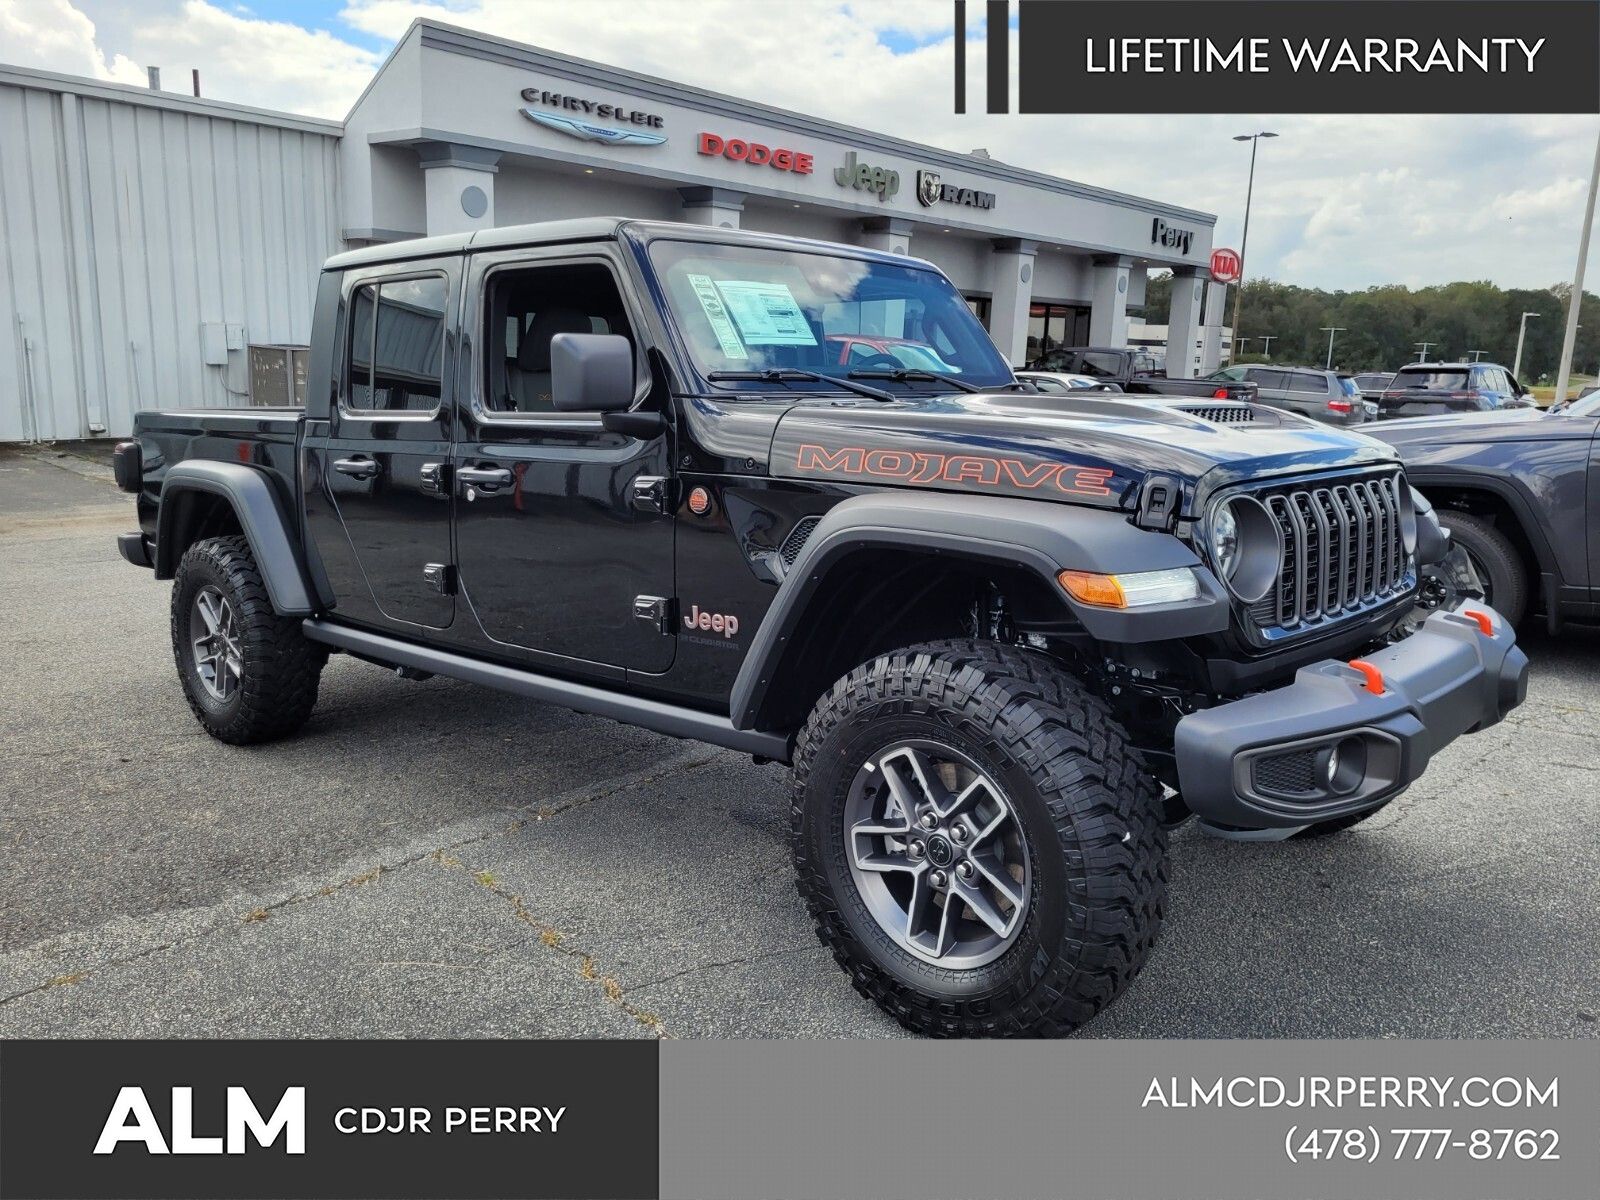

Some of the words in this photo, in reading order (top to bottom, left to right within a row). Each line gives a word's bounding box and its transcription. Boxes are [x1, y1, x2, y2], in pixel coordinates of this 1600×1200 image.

[520, 87, 664, 128] CHRYSLER
[697, 132, 813, 174] DODGE
[834, 151, 899, 202] Jeep
[941, 184, 996, 209] RAM
[1152, 217, 1195, 255] Perry
[1214, 255, 1238, 276] KIA
[798, 445, 1114, 496] MOJAVE
[684, 605, 739, 638] Jeep
